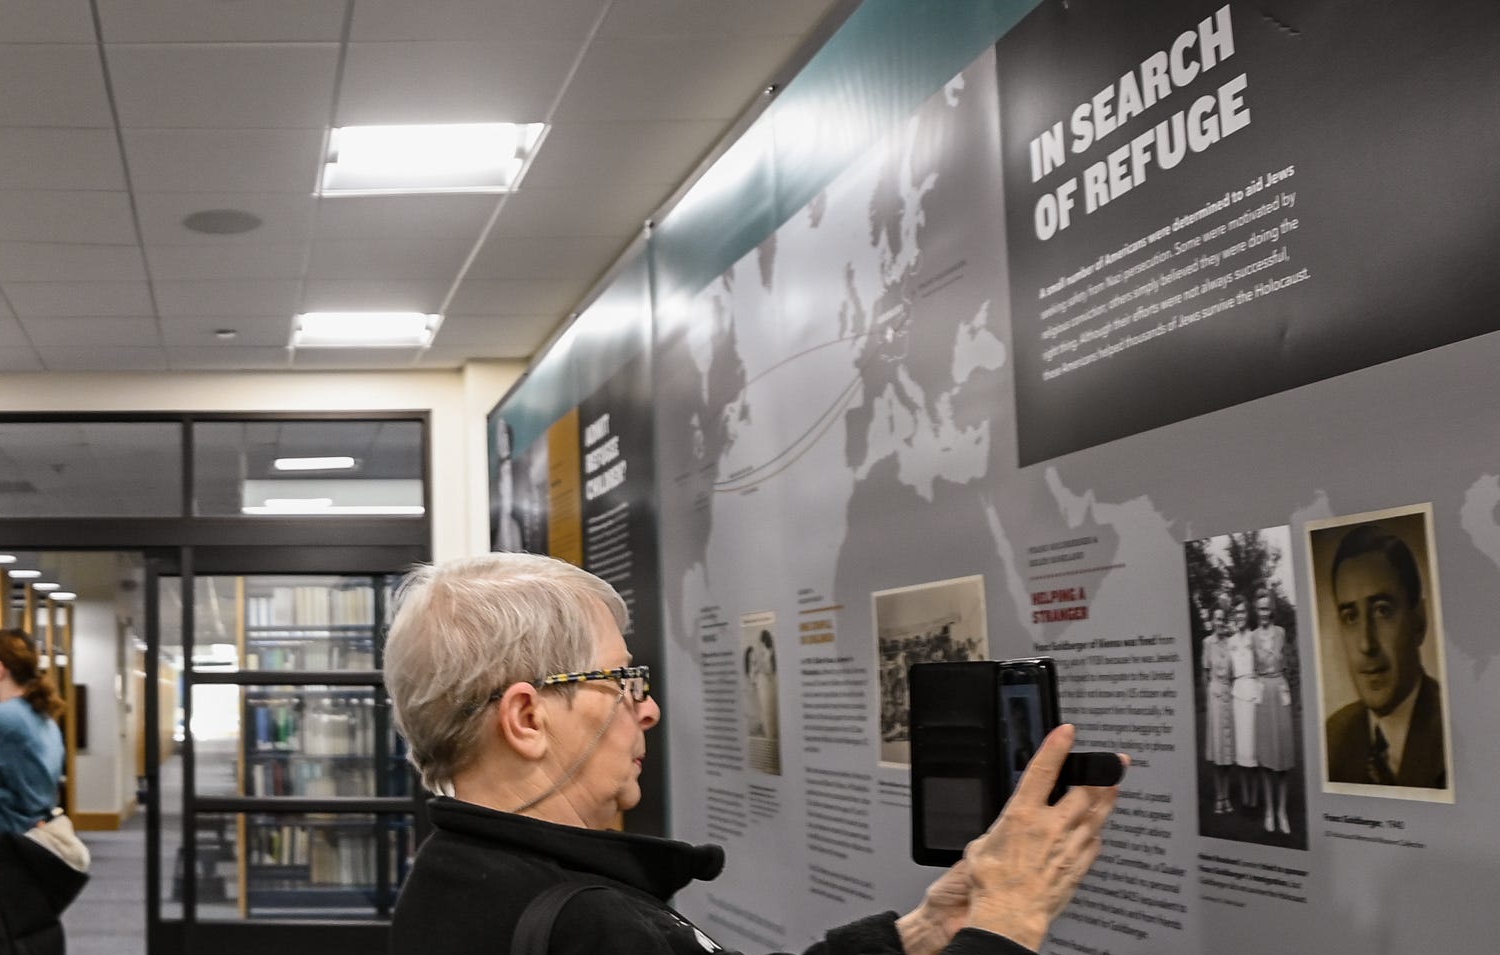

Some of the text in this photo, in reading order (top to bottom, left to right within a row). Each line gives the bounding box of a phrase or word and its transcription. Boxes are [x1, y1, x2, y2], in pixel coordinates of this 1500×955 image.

[1030, 4, 1235, 183] IN SEARCH
[1034, 73, 1250, 241] OF REFUGE
[1104, 238, 1148, 267] Americans
[1147, 224, 1172, 245] were
[1171, 193, 1230, 233] determined
[1231, 187, 1244, 203] to
[1244, 176, 1263, 198] aid
[1264, 164, 1295, 188] Jews
[1174, 234, 1202, 256] Some
[1202, 224, 1226, 245] were
[1227, 199, 1280, 238] motivated
[1280, 190, 1296, 210] by
[1160, 259, 1199, 290] believed
[1199, 248, 1220, 272] they
[1221, 240, 1247, 259] were
[1248, 226, 1279, 250] doing
[1279, 215, 1299, 233] the
[1160, 292, 1182, 310] were
[1182, 285, 1200, 303] not
[1200, 268, 1233, 295] always
[1233, 245, 1290, 280] successful,
[1177, 308, 1201, 329] Jews
[1201, 295, 1235, 319] survive
[1235, 286, 1254, 304] the
[1253, 267, 1311, 299] Holocaust.
[1031, 588, 1076, 606] HELPING
[1032, 605, 1090, 624] STRANGER
